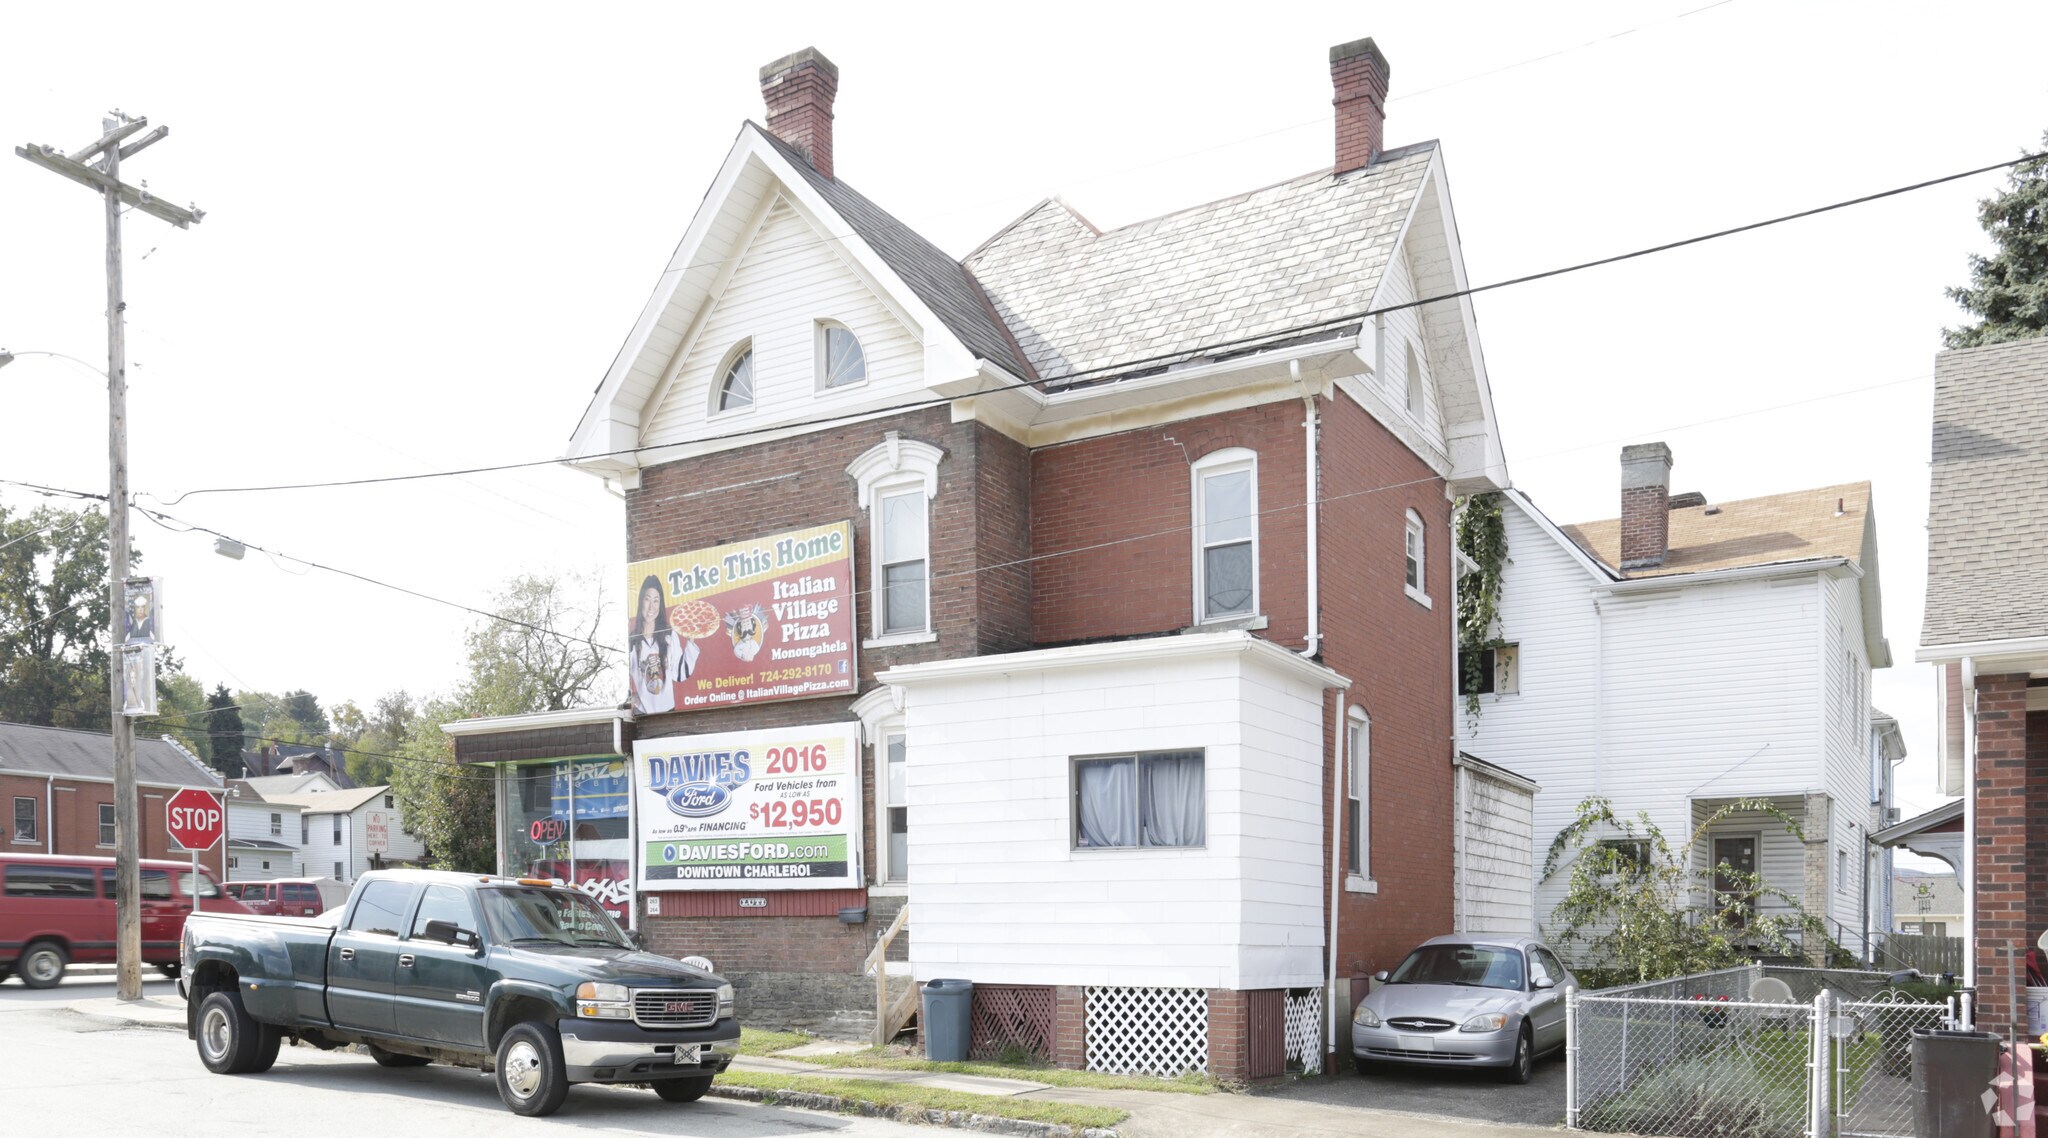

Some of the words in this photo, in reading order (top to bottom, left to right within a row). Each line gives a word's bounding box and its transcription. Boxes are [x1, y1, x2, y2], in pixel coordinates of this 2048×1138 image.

[668, 564, 720, 597] Take
[723, 548, 771, 581] This
[775, 531, 842, 567] Home
[772, 576, 836, 600] Italian
[771, 598, 839, 622] Village
[781, 622, 831, 642] Pizza
[771, 640, 848, 661] Monongahela
[697, 679, 713, 690] We
[715, 674, 754, 688] Deliver!
[760, 663, 832, 683] 724-292-8170
[684, 694, 708, 705] Order
[709, 691, 736, 703] Online
[746, 679, 849, 698] ItalianVillagePizza.com
[766, 744, 827, 774] 2016
[648, 749, 750, 791] DAVIES
[754, 783, 774, 792] Ford
[776, 780, 813, 791] Vehicles
[816, 779, 837, 788] from
[681, 787, 716, 807] Ford
[171, 807, 220, 831] STOP
[367, 824, 387, 833] PARKING
[699, 822, 746, 832] FINANCING
[530, 820, 563, 840] OPEN
[677, 864, 741, 879] DOWNTOWN
[744, 864, 811, 877] CHARLEROI
[665, 1001, 695, 1013] GMC
